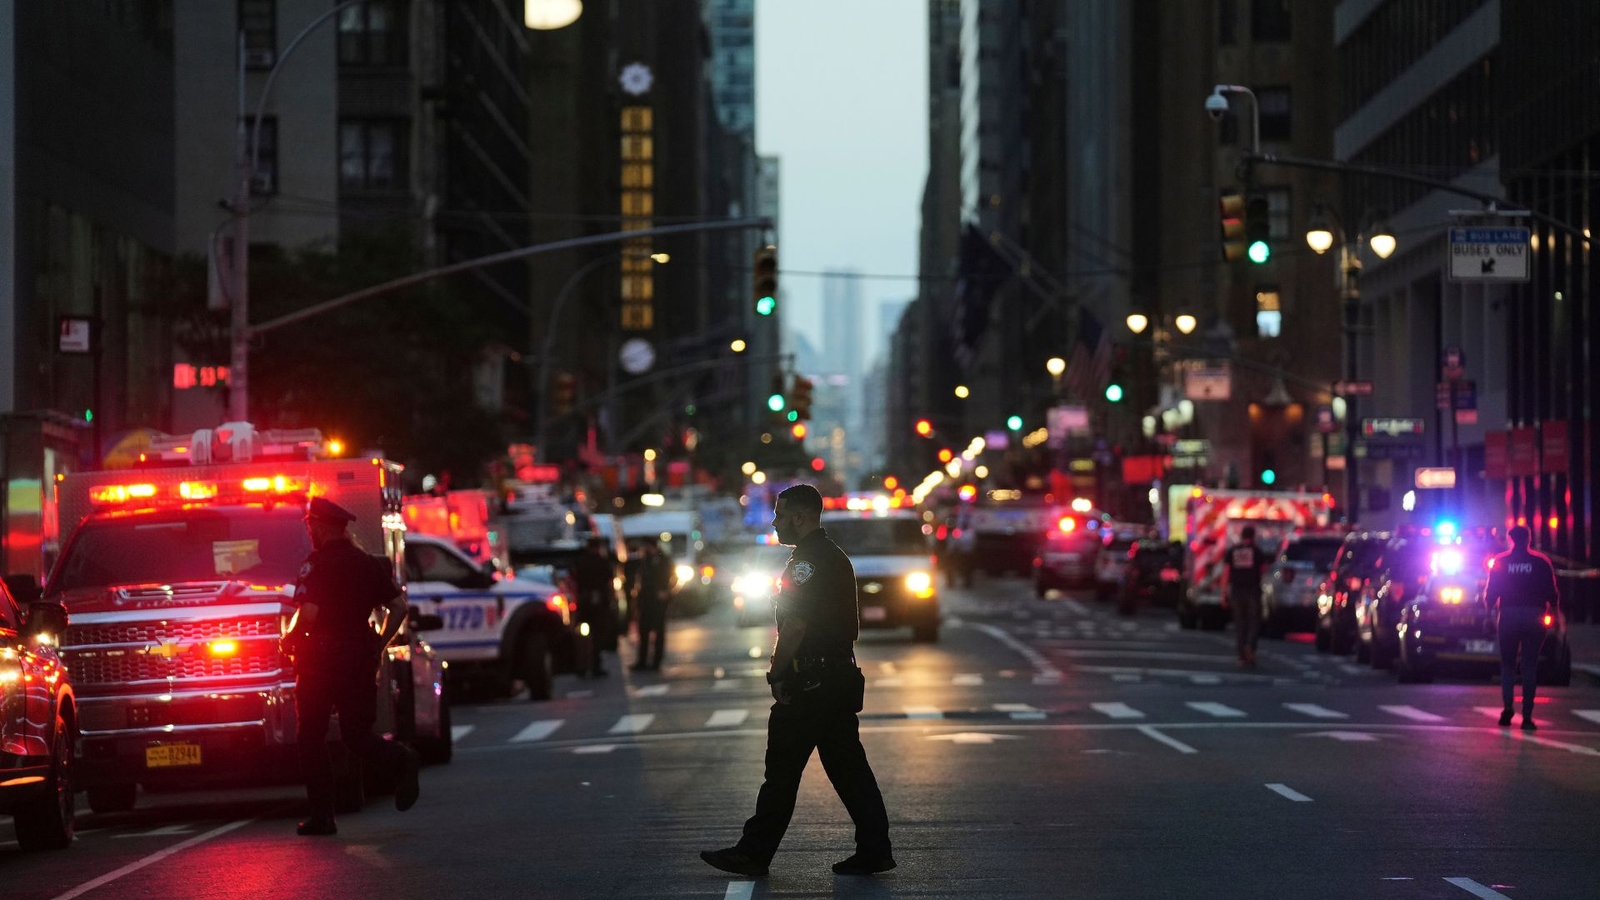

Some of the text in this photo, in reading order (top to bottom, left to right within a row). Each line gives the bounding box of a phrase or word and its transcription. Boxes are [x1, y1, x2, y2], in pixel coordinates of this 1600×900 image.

[1470, 231, 1522, 240] BUS LANE
[1454, 244, 1523, 256] BUSES ONLY
[1508, 562, 1533, 574] NYPD
